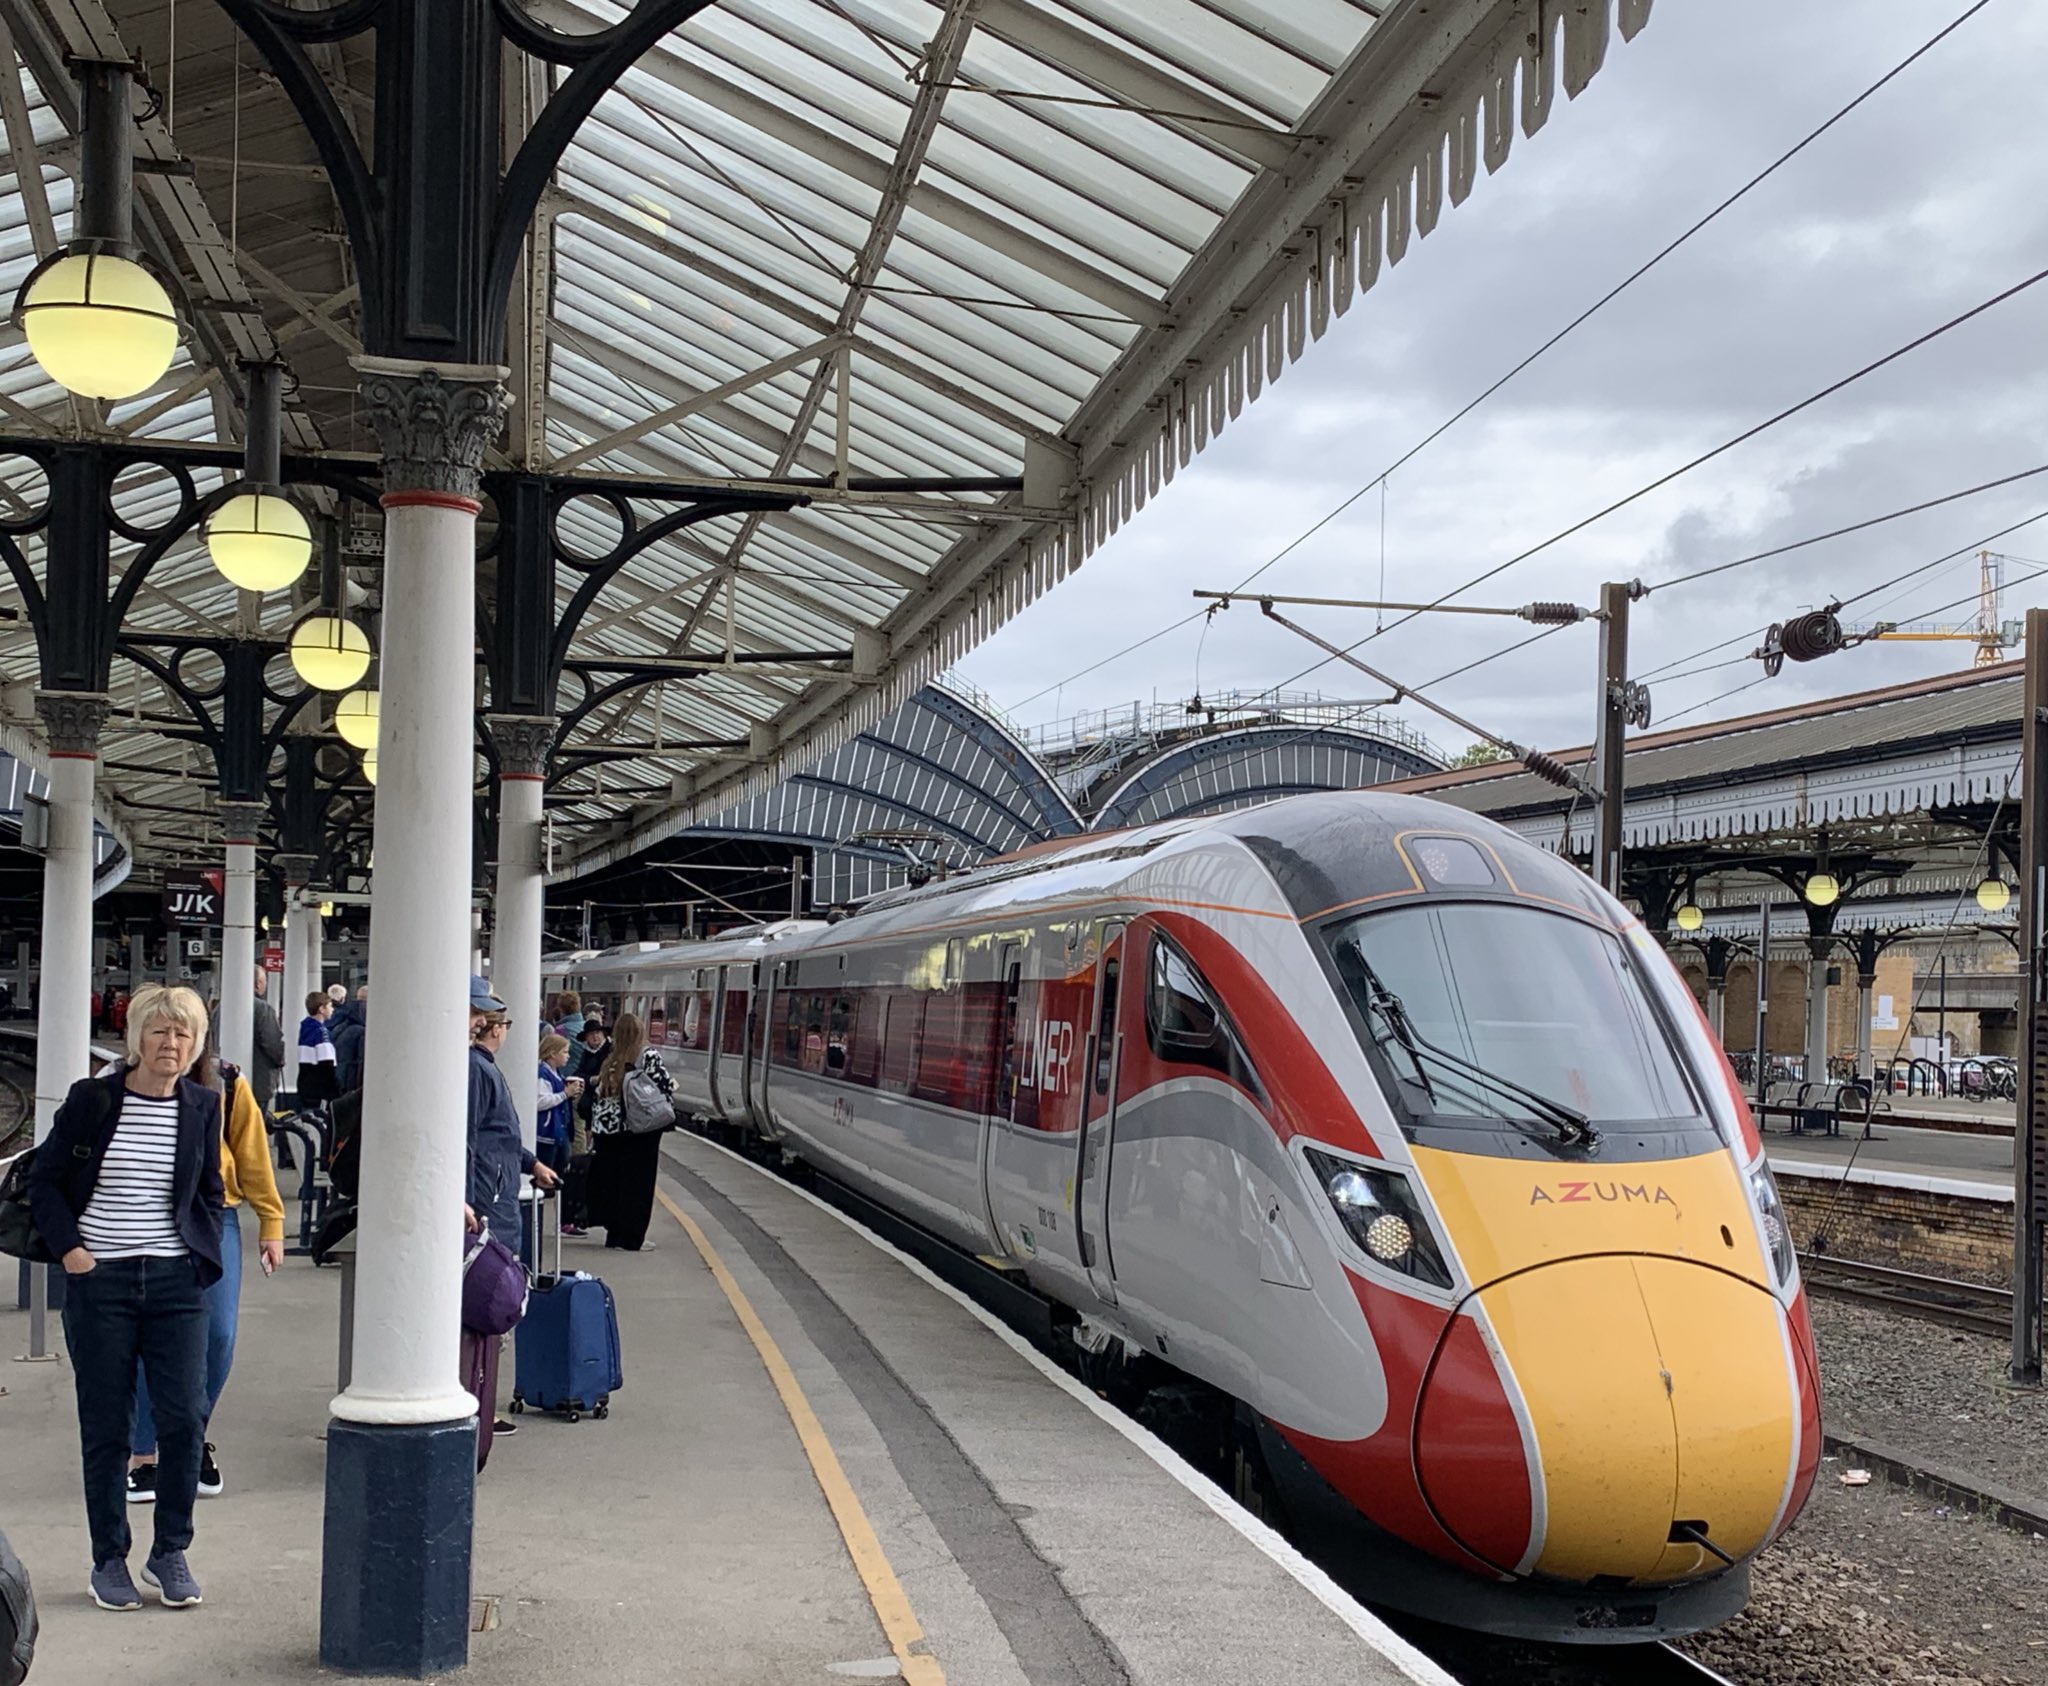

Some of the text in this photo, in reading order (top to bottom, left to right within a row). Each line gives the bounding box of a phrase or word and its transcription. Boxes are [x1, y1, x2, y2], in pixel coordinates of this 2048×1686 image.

[168, 893, 214, 914] J/K
[191, 942, 201, 954] 6
[1020, 1005, 1073, 1104] LNER
[1530, 1182, 1677, 1206] AZUMA
